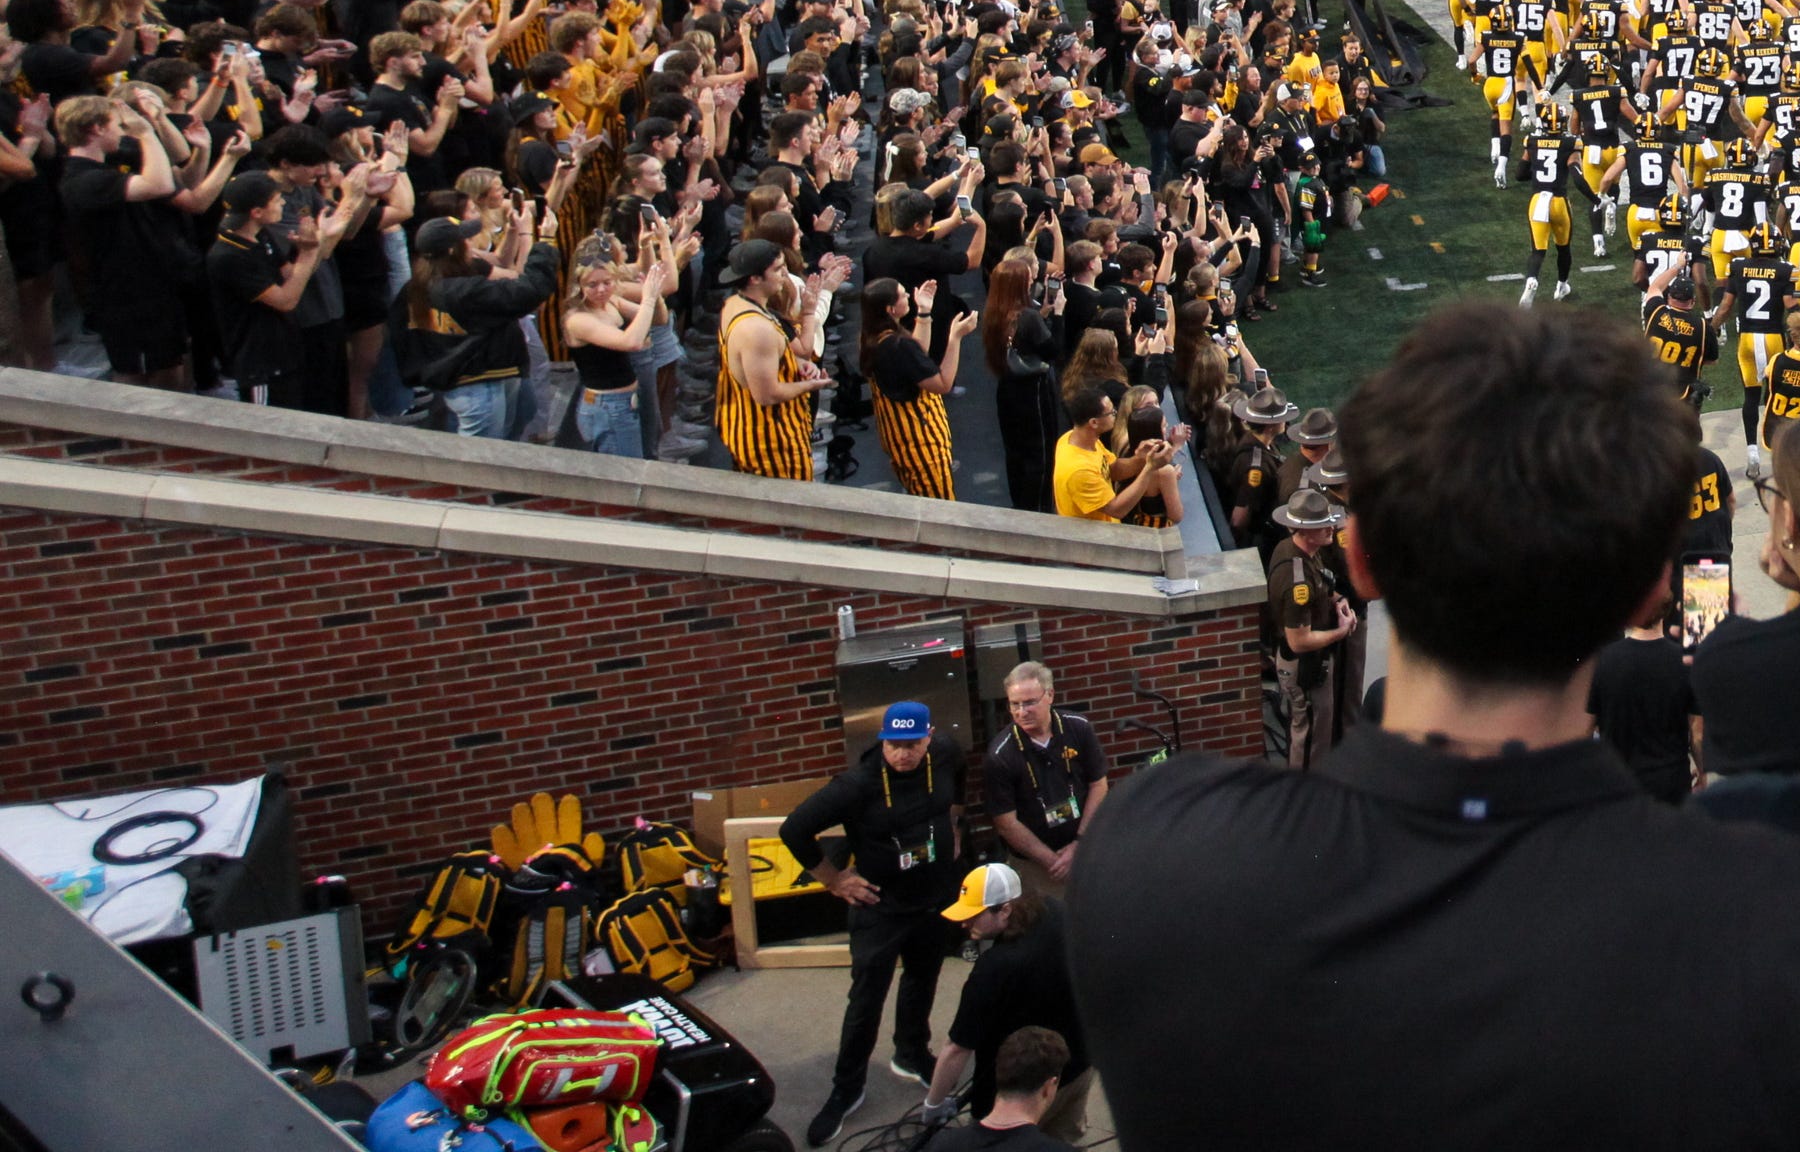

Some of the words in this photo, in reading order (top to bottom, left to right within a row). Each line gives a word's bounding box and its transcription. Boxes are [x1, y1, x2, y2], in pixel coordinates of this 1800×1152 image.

[1516, 3, 1544, 31] 15
[1699, 13, 1731, 40] 85
[1489, 39, 1517, 48] ANDERSON
[1492, 48, 1512, 75] 6
[1667, 48, 1695, 77] 17
[1744, 56, 1781, 85] 23
[1693, 83, 1719, 95] EPENESA
[1590, 100, 1608, 130] 1
[1685, 91, 1724, 124] 97
[1537, 139, 1561, 148] WATSON
[1536, 149, 1558, 183] 3
[1640, 153, 1663, 186] 6
[1711, 173, 1750, 183] WASHINGTON
[1752, 175, 1763, 184] JR
[1720, 182, 1744, 218] 8
[1657, 238, 1683, 248] McNEIL
[1742, 267, 1776, 279] PHILLIPS
[1745, 280, 1772, 320] 2
[648, 996, 679, 1015] CARE
[671, 1014, 711, 1043] HEALTH
